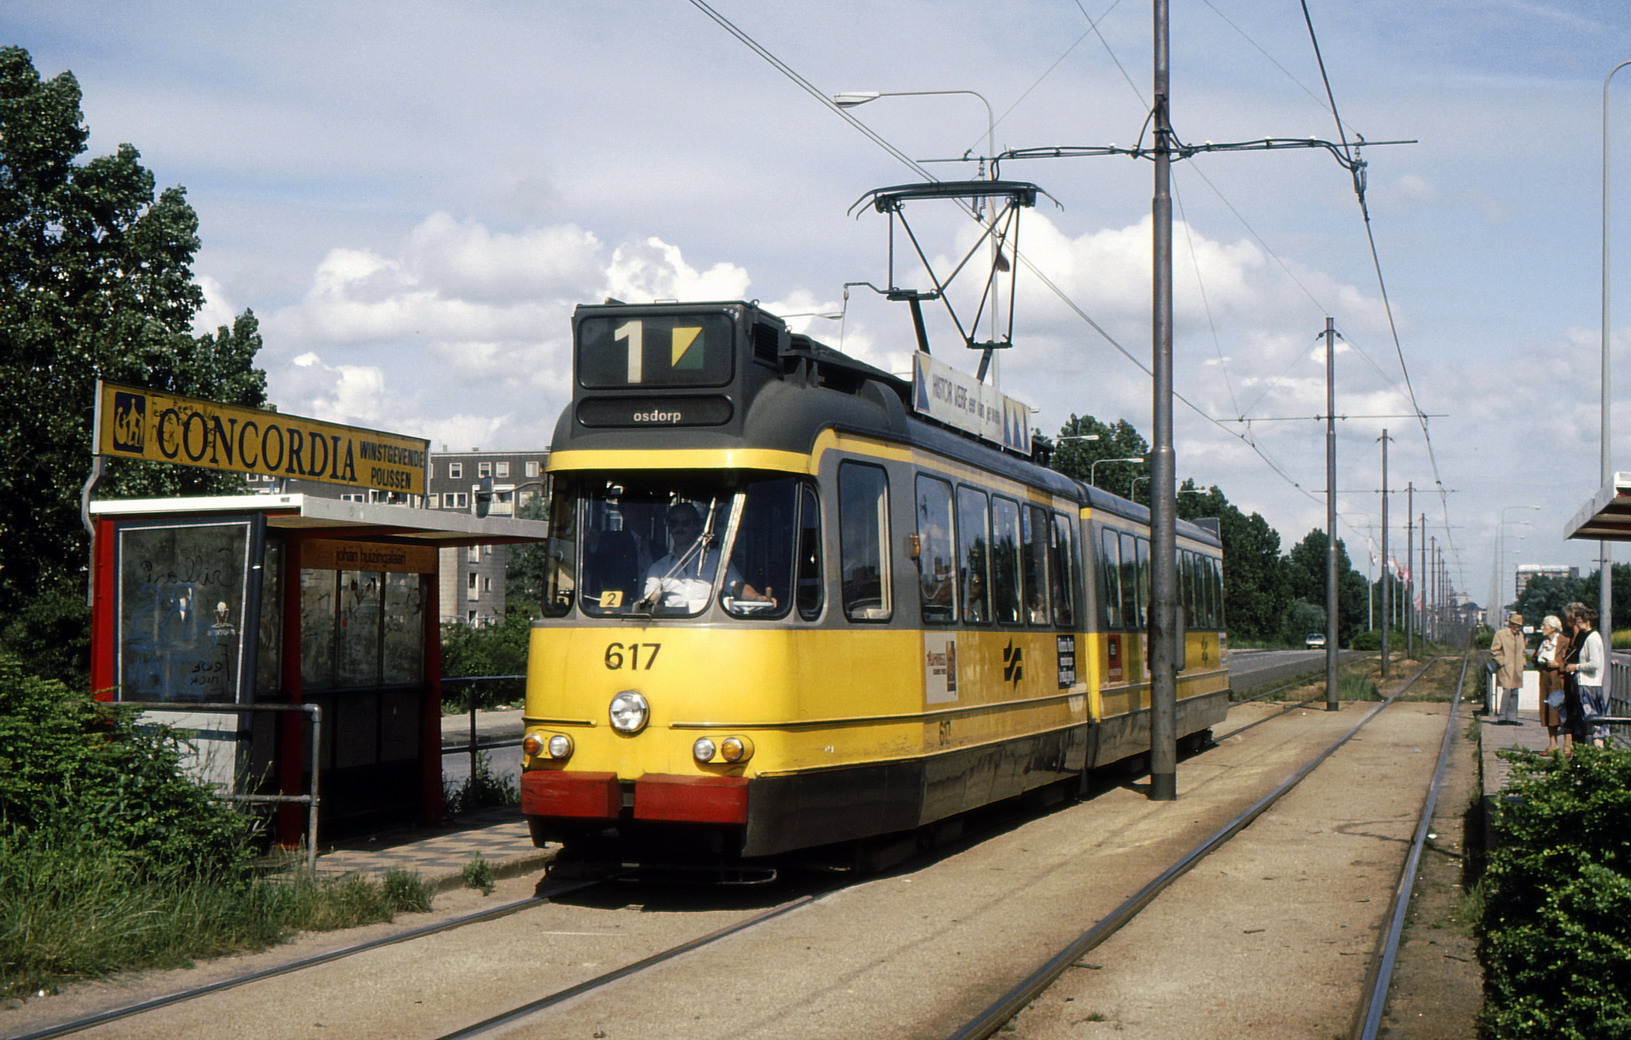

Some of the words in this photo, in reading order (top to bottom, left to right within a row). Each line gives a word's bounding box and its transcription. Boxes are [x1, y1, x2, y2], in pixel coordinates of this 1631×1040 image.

[614, 320, 642, 384] 1
[633, 410, 682, 424] osdorp
[157, 408, 357, 482] CONCORDIA
[360, 441, 425, 468] WINSTGEVENDE
[370, 467, 412, 489] POLISSEN
[335, 546, 358, 565] johan
[606, 592, 617, 606] 2
[604, 642, 662, 671] 617
[939, 720, 951, 746] 617
